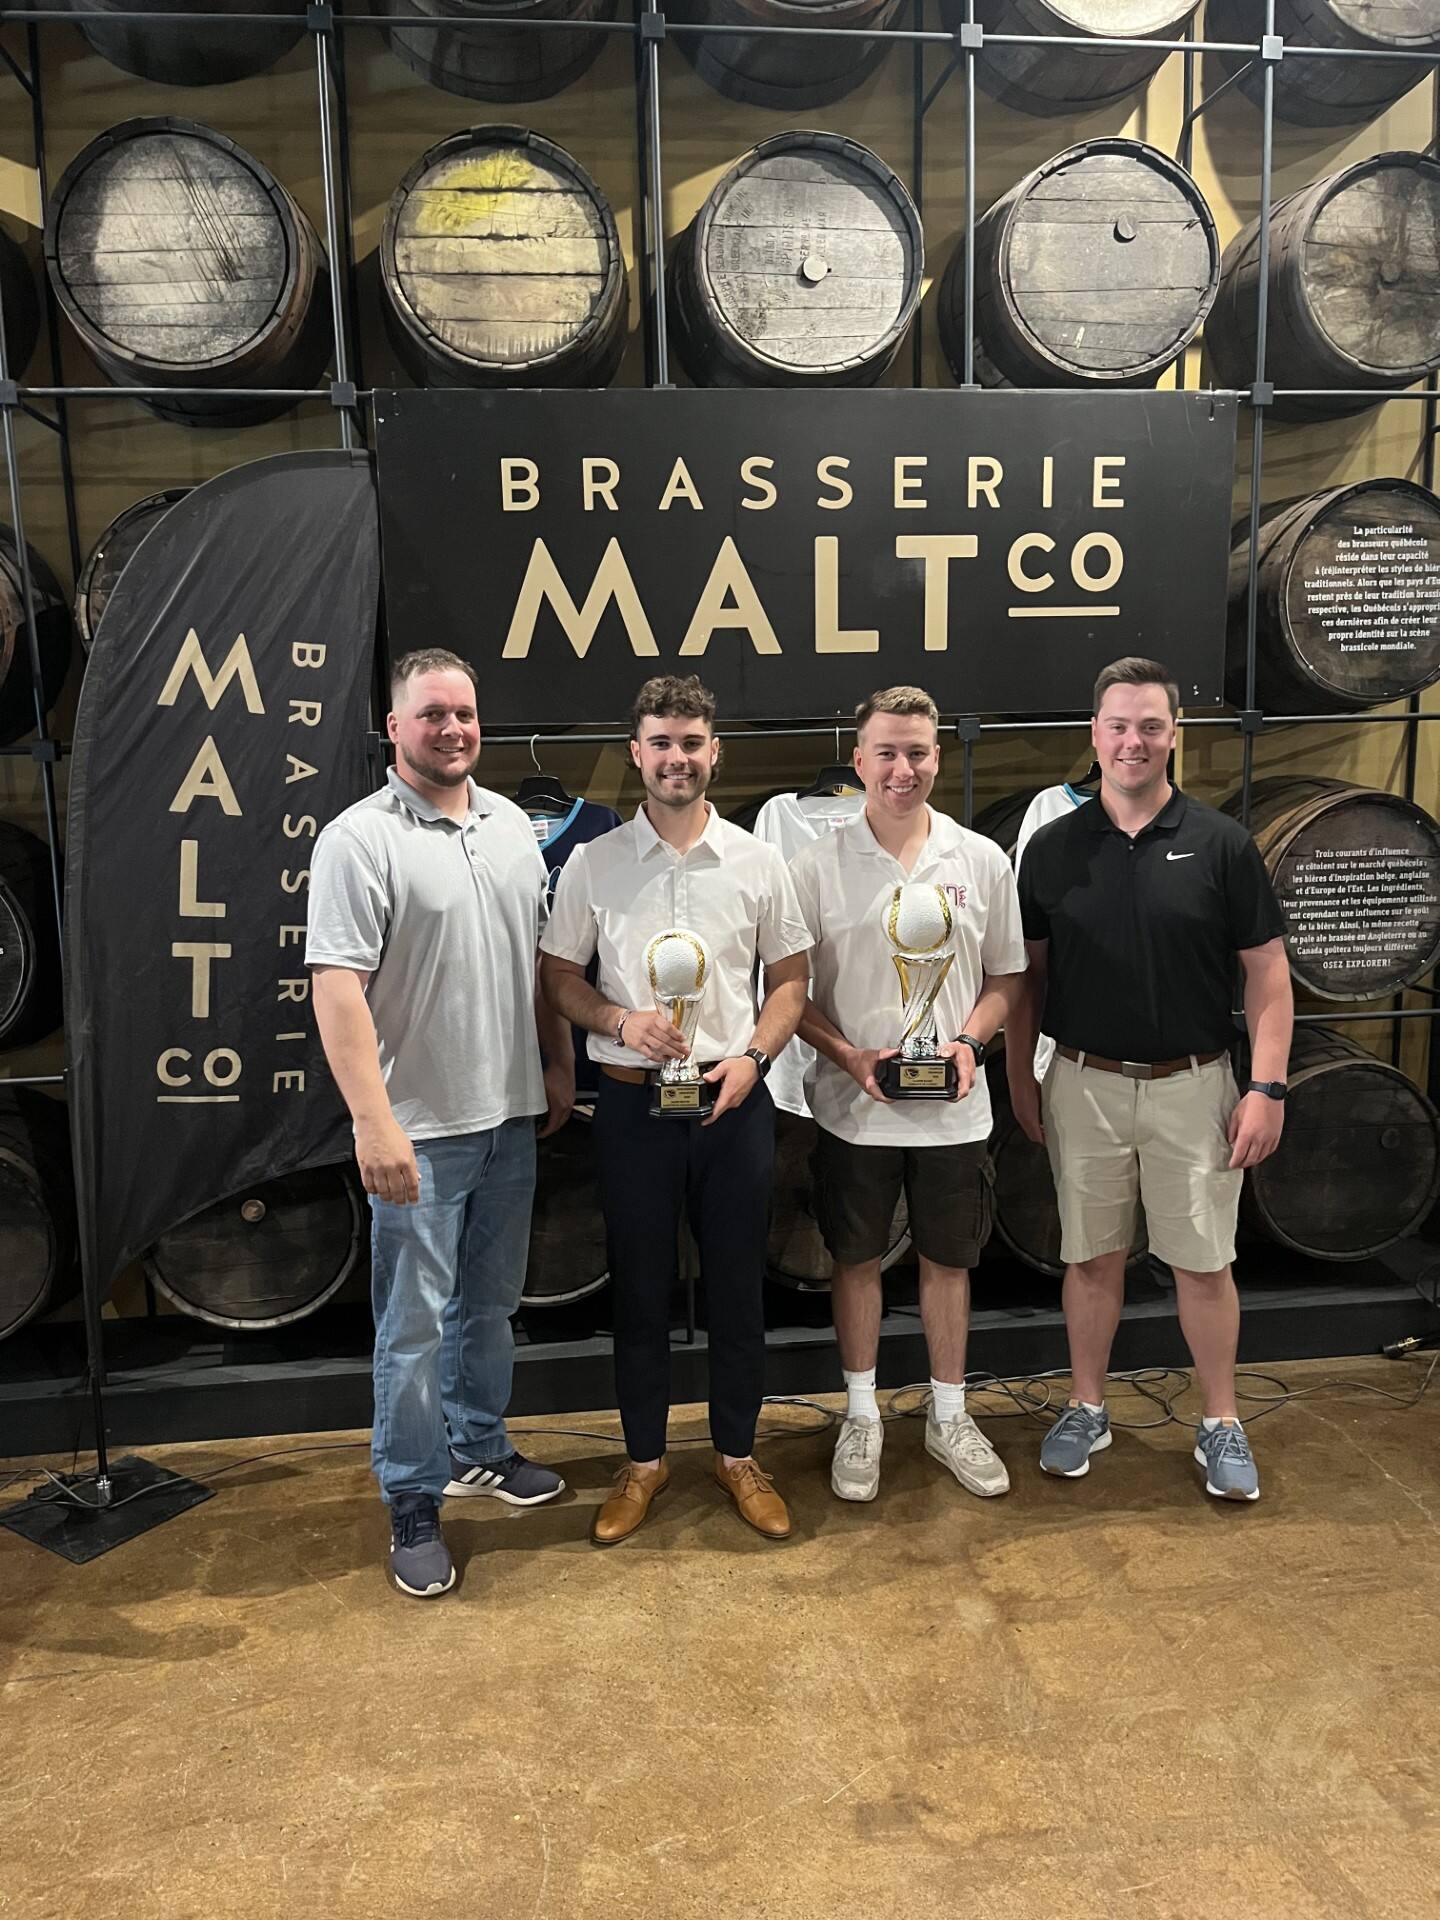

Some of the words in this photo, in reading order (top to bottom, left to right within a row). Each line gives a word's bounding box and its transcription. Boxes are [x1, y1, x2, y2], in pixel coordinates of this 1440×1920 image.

[501, 456, 1125, 510] BRASSERIE
[1364, 525, 1412, 536] particularité
[1338, 540, 1350, 548] des
[1352, 540, 1388, 548] brasseurs
[1390, 538, 1428, 549] québécois
[1336, 552, 1360, 562] réside
[1360, 552, 1378, 560] dans
[1380, 552, 1396, 560] leur
[1397, 550, 1429, 562] capacité
[1390, 564, 1412, 574] styles
[1304, 579, 1355, 588] traditionnels.
[1356, 578, 1377, 587] Alors
[1378, 579, 1392, 588] que
[1406, 579, 1424, 587] pays
[502, 535, 978, 658] MALT
[1008, 532, 1123, 592] CO
[1308, 593, 1334, 602] restent
[1336, 592, 1352, 602] près
[1364, 591, 1380, 600] leur
[1382, 590, 1414, 599] tradition
[1308, 605, 1348, 616] respective,
[1363, 603, 1400, 612] Québécois
[1336, 618, 1372, 626] dernières
[1373, 616, 1388, 625] afin
[1400, 616, 1420, 624] créer
[1422, 615, 1438, 624] leur
[1328, 632, 1354, 642] propre
[1355, 629, 1384, 638] identité
[1408, 628, 1430, 636] scène
[1340, 643, 1378, 652] brassicole
[1380, 642, 1416, 650] mondiale.
[157, 628, 265, 1017] MALT
[1315, 850, 1334, 858] Trois
[1336, 849, 1367, 857] courants
[1368, 848, 1410, 856] d'influence
[274, 642, 326, 1092] BRASSERIE
[1306, 862, 1335, 870] côtoient
[1358, 860, 1386, 868] marché
[1387, 858, 1422, 869] québécois
[1304, 874, 1327, 882] bières
[1328, 872, 1374, 883] d'inspiration
[1399, 870, 1430, 880] anglaise
[1304, 886, 1336, 896] d'Europe
[1348, 884, 1366, 892] l'Est.
[1283, 900, 1298, 908] leur
[1299, 900, 1340, 908] provenance
[1362, 896, 1408, 906] équipements
[1410, 894, 1437, 902] utilisés
[1302, 910, 1339, 920] cependant
[1356, 908, 1390, 916] influence
[1414, 906, 1430, 916] goût
[1316, 922, 1338, 930] bière.
[1300, 934, 1314, 944] pale
[1368, 932, 1406, 941] Angleterre
[1297, 946, 1322, 955] Canada
[1324, 946, 1352, 956] goûtera
[1352, 944, 1382, 954] toujours
[1322, 960, 1343, 969] OSEZ
[1346, 958, 1391, 968] EXPLORER!
[157, 1048, 241, 1086] CO
